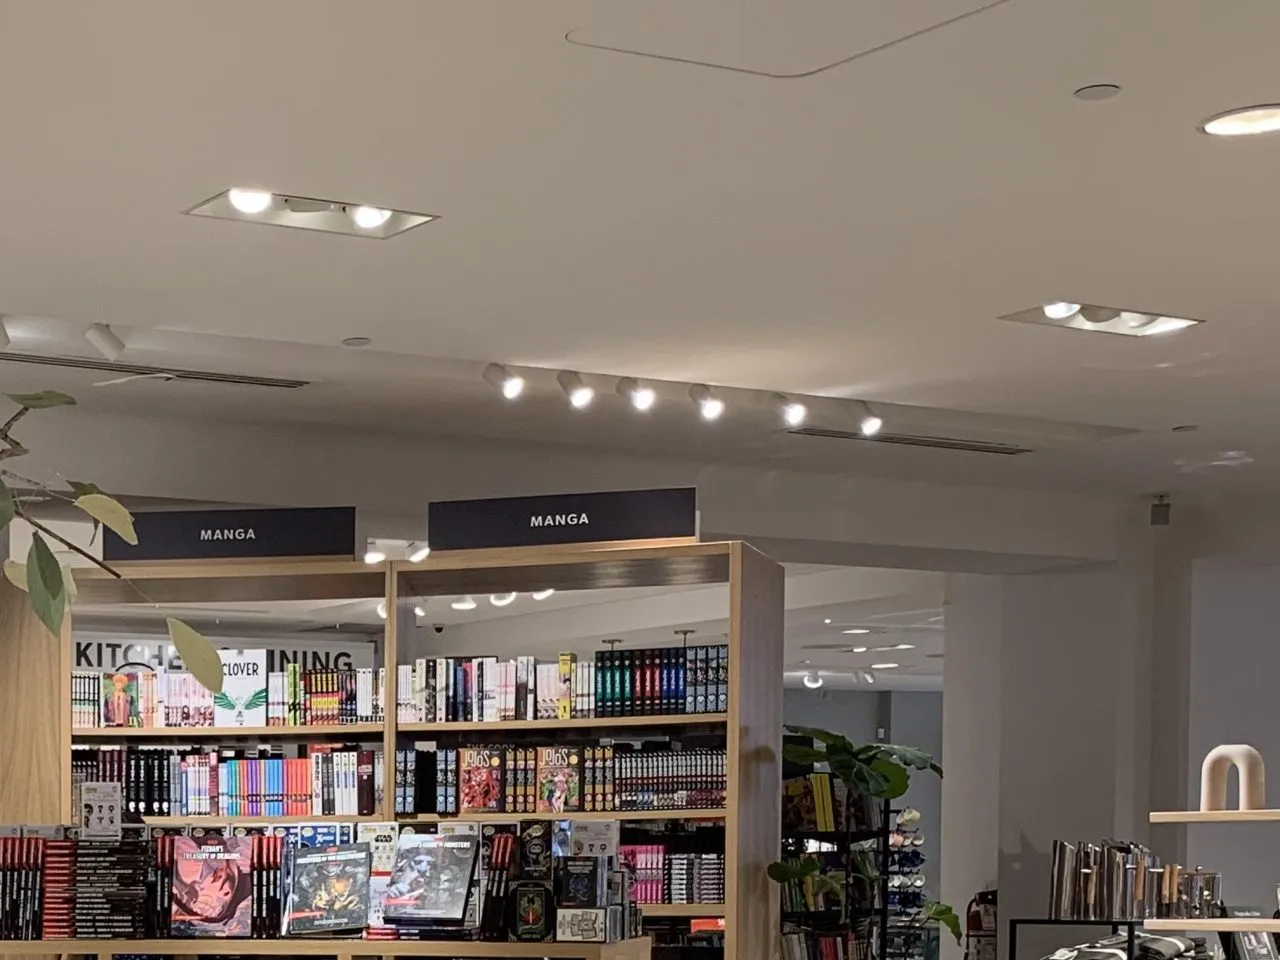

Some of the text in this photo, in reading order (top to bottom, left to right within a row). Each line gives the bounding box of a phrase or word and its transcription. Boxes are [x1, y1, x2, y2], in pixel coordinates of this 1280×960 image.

[530, 512, 590, 528] MANGA
[199, 528, 256, 541] MANGA
[75, 642, 353, 672] KITCHE INING
